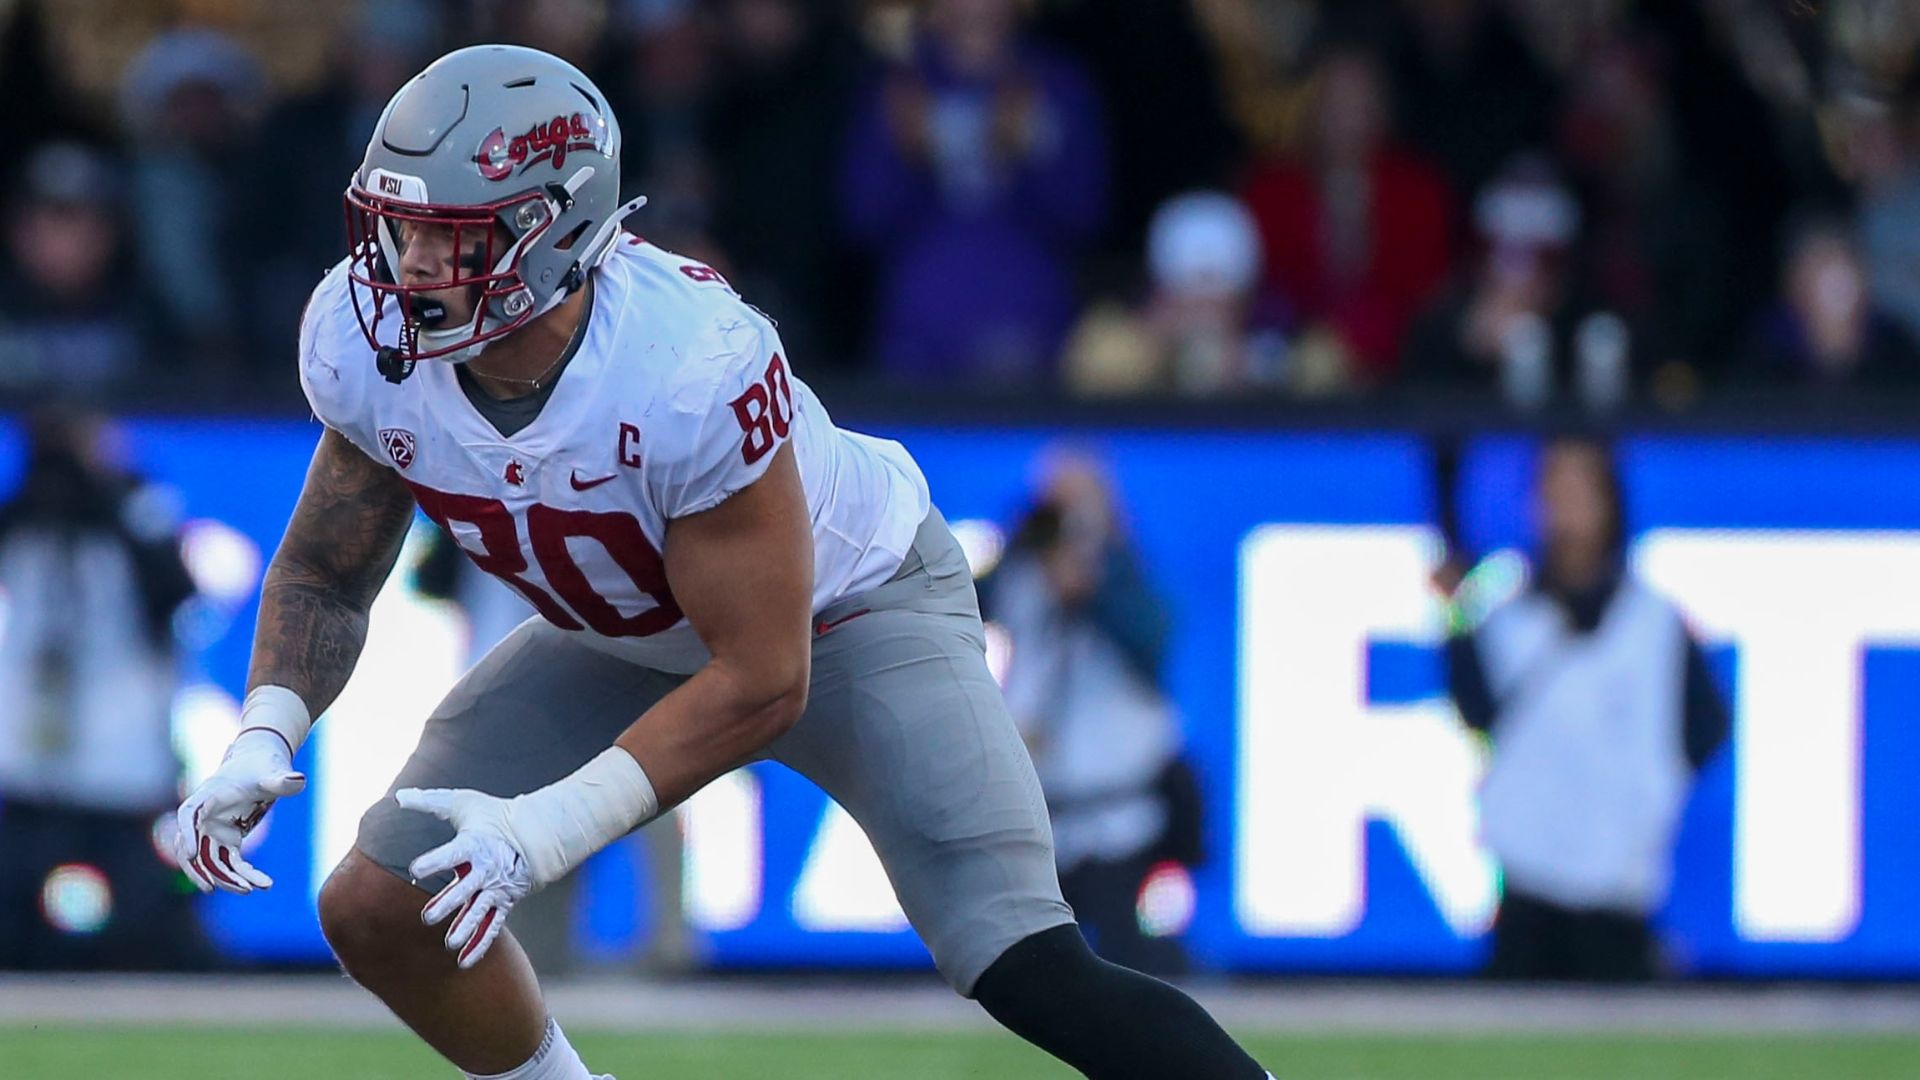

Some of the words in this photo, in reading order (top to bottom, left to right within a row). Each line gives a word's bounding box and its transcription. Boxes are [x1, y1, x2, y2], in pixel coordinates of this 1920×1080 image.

[379, 174, 402, 196] WSU
[727, 351, 794, 466] 80
[391, 446, 410, 463] 12
[618, 421, 642, 469] C
